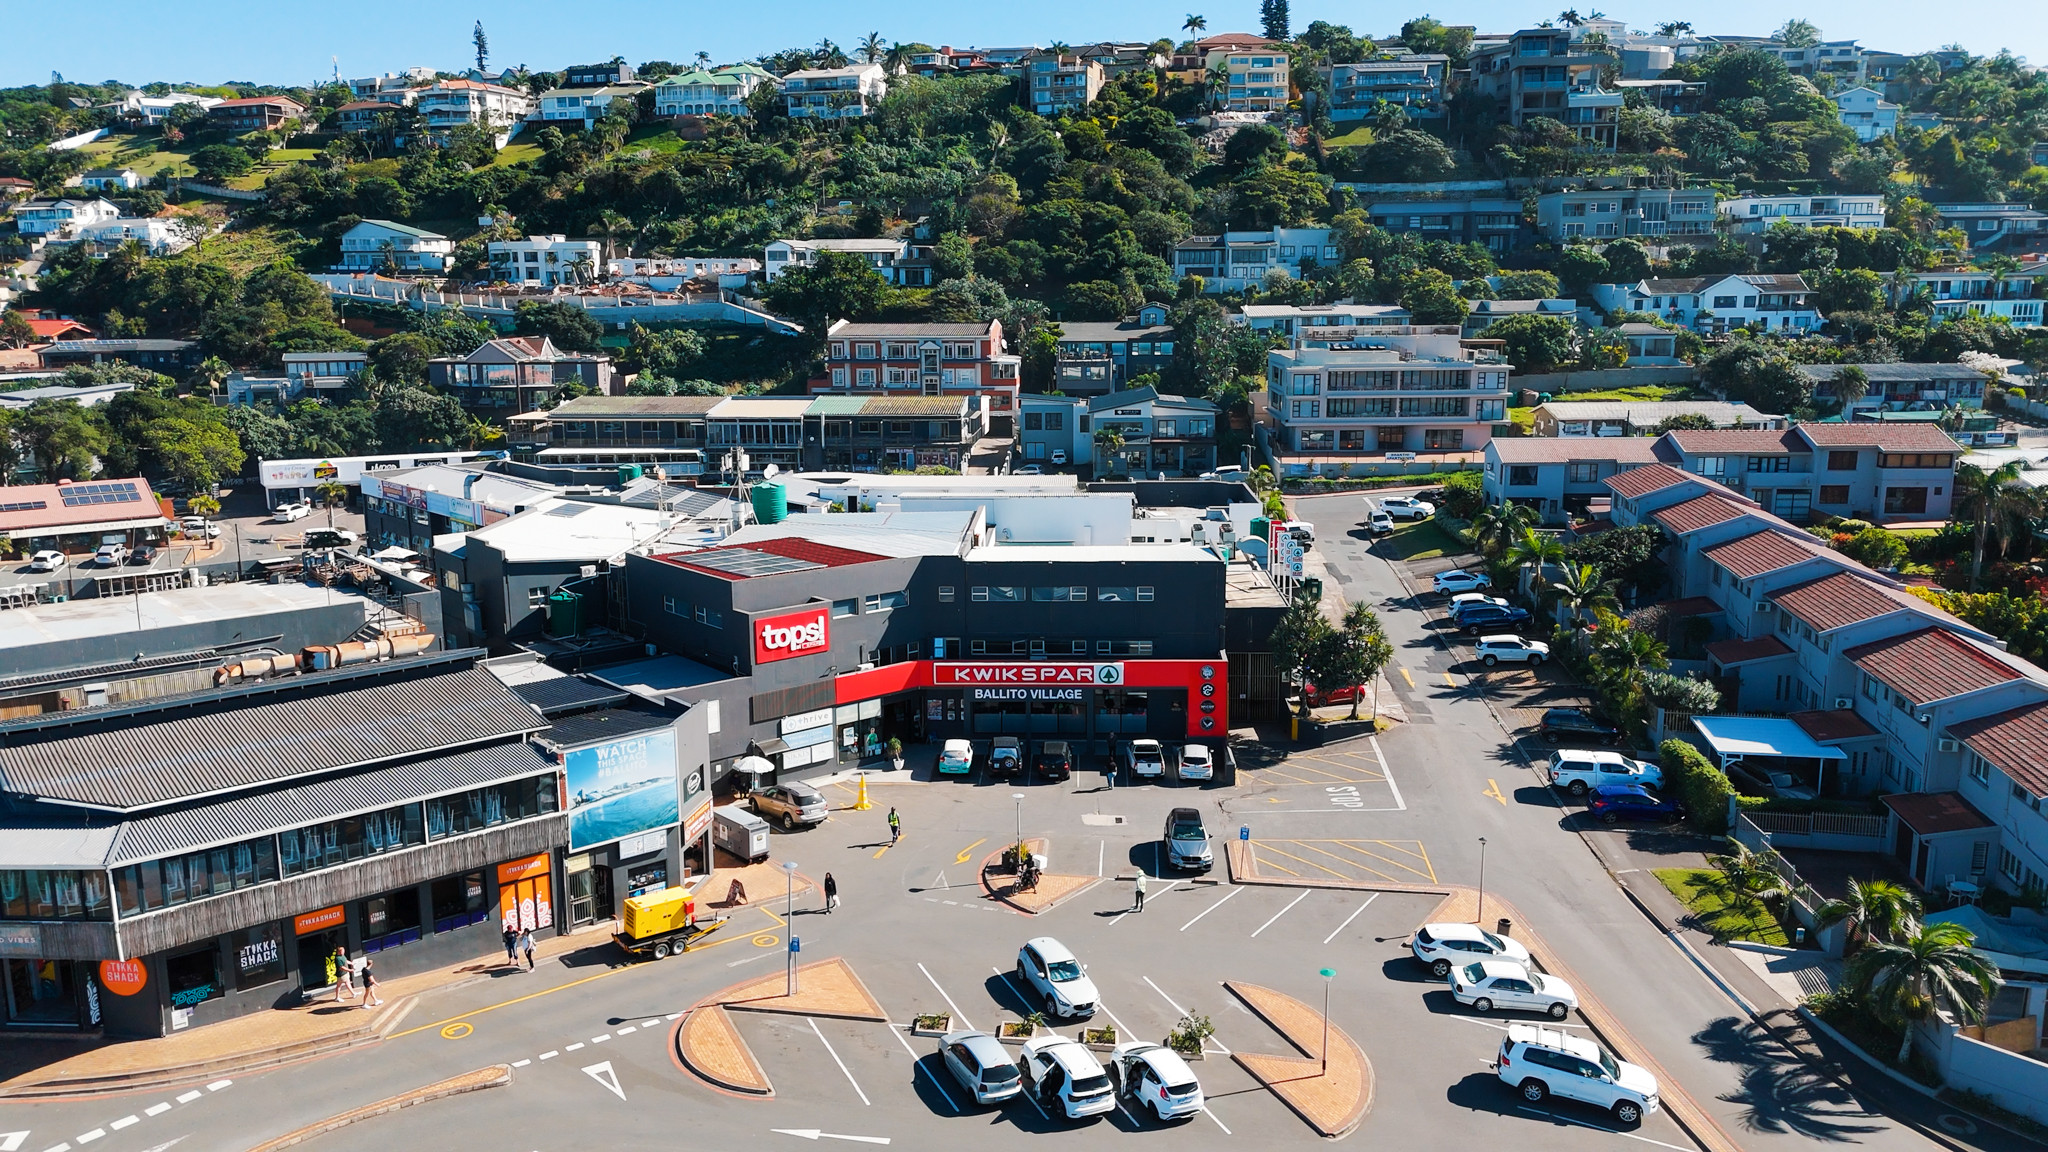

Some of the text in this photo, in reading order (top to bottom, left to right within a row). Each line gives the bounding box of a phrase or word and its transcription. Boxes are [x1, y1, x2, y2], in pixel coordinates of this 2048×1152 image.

[762, 616, 825, 651] tops!
[955, 667, 1093, 681] KWIKSPAR
[974, 688, 1083, 700] BALLITO VILLAGE
[596, 739, 647, 761] WATCH
[597, 751, 647, 769] THIS SPACE
[598, 760, 648, 777] #BALLITO
[1325, 786, 1364, 808] STOP
[244, 939, 277, 956] TIKKA
[110, 962, 138, 972] TIKKA
[240, 949, 278, 968] SHACK
[107, 972, 139, 982] SHACK
